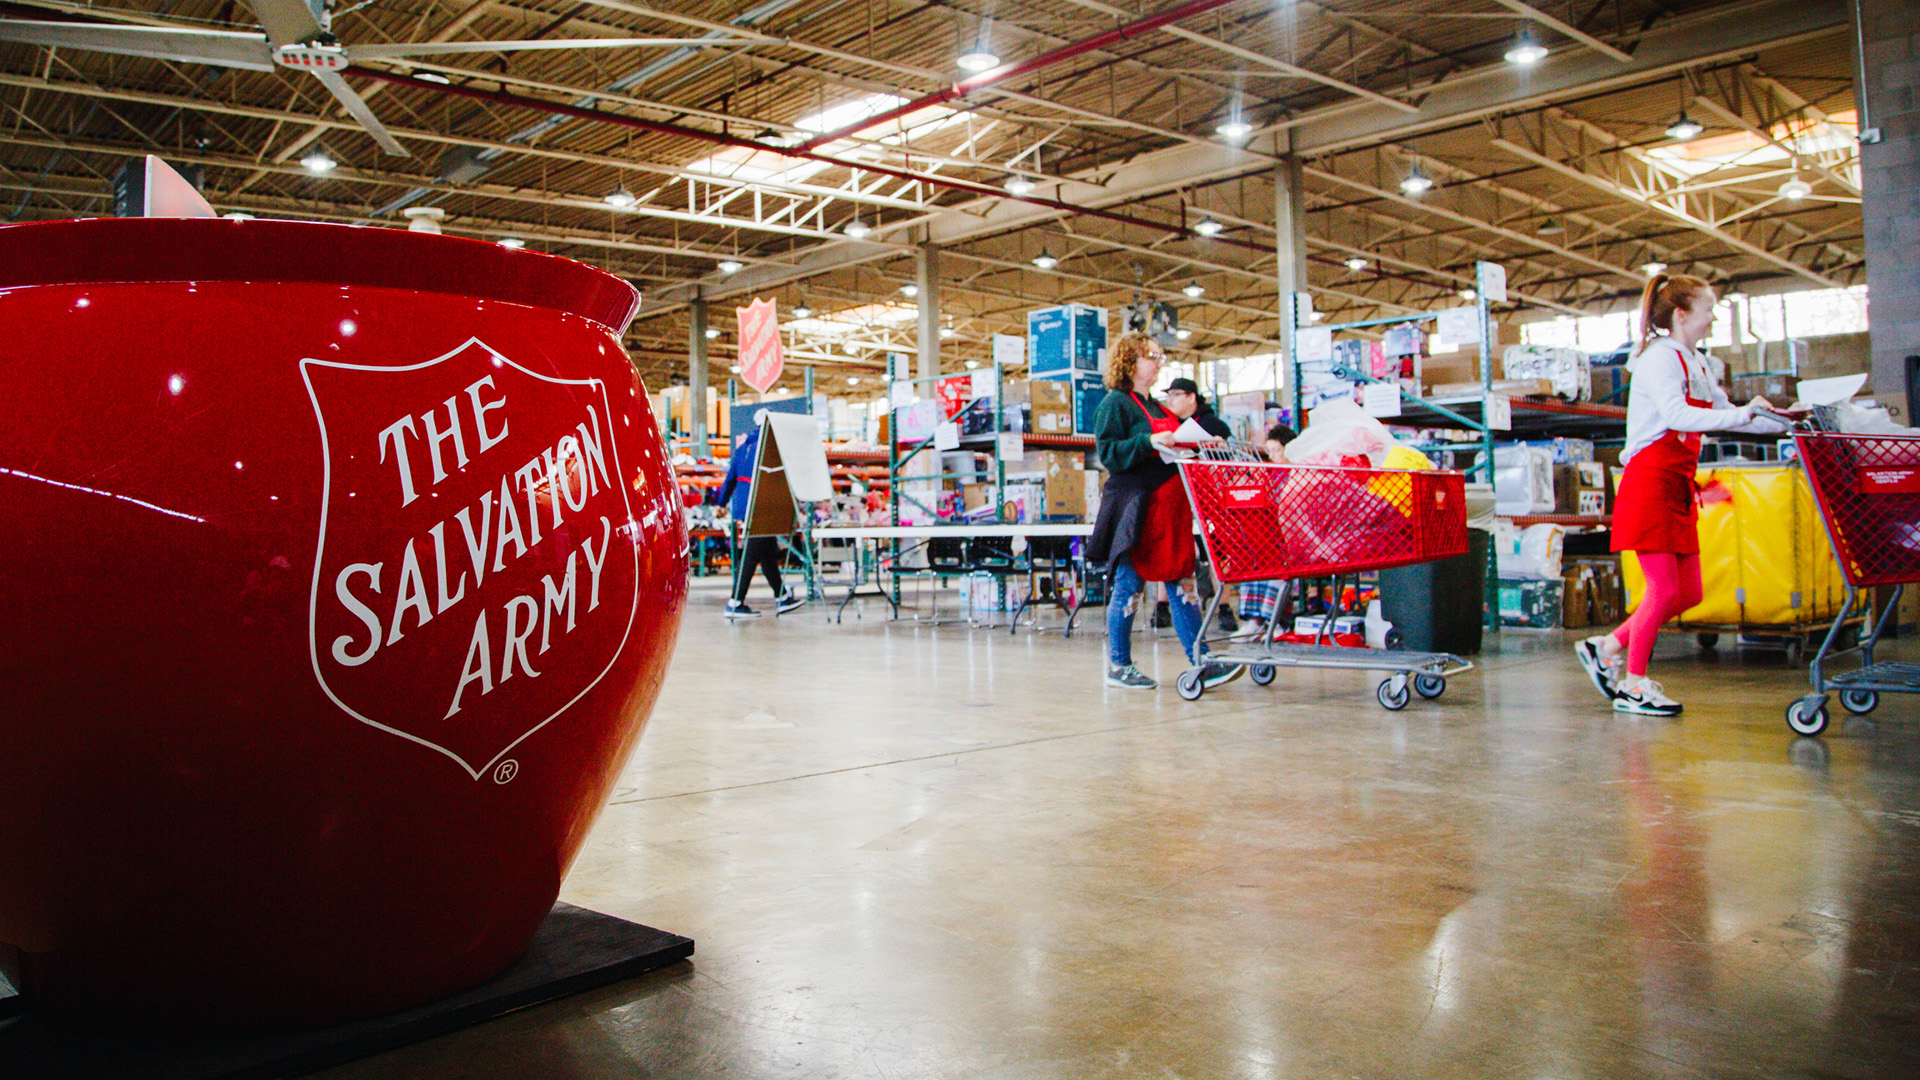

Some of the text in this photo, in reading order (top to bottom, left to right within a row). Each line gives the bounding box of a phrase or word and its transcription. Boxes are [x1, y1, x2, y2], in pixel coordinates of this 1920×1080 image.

[331, 404, 611, 667] SALVATION
[379, 374, 509, 509] THE
[443, 516, 611, 721] ARMY
